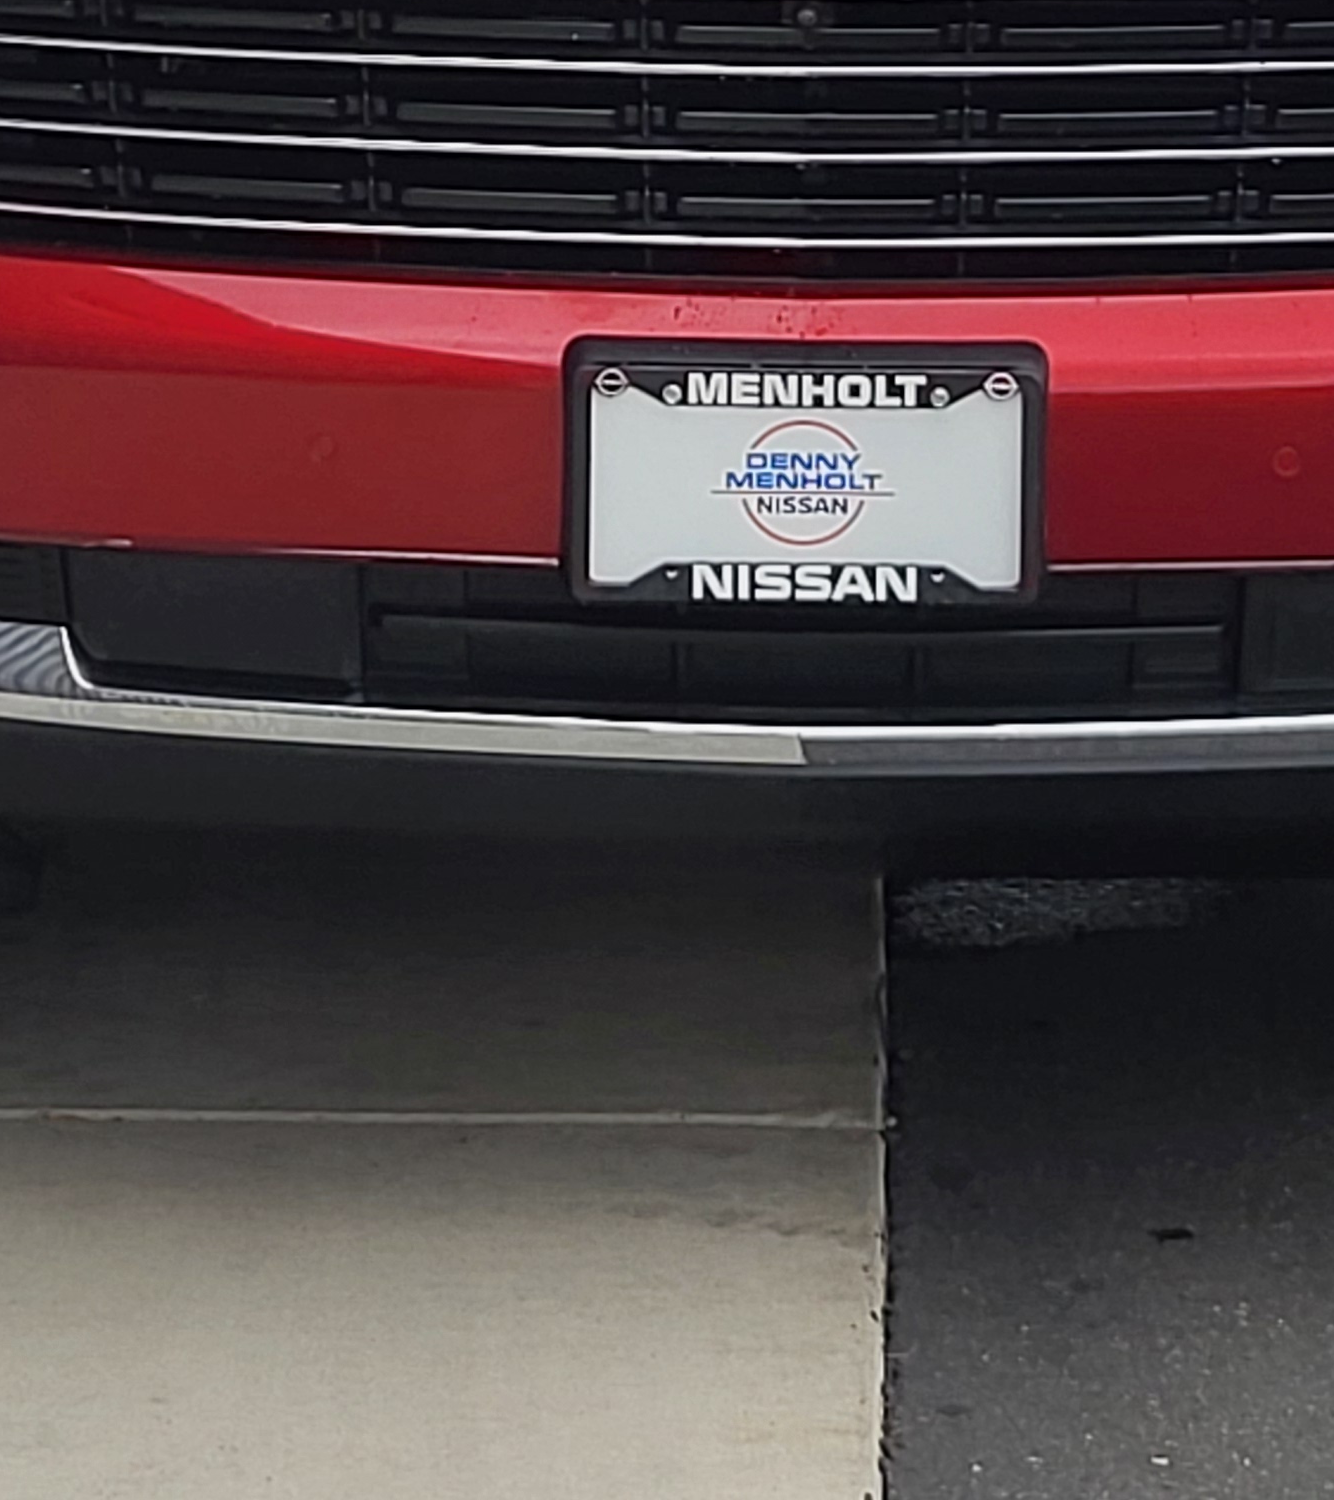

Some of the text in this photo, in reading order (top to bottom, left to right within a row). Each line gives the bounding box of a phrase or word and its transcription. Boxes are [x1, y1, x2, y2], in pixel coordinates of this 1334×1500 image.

[688, 372, 927, 407] MENHOLT
[746, 453, 861, 470] DENNY
[726, 472, 883, 490] MENHOLT
[757, 496, 849, 514] NISSAN
[692, 564, 918, 601] NISSAN
